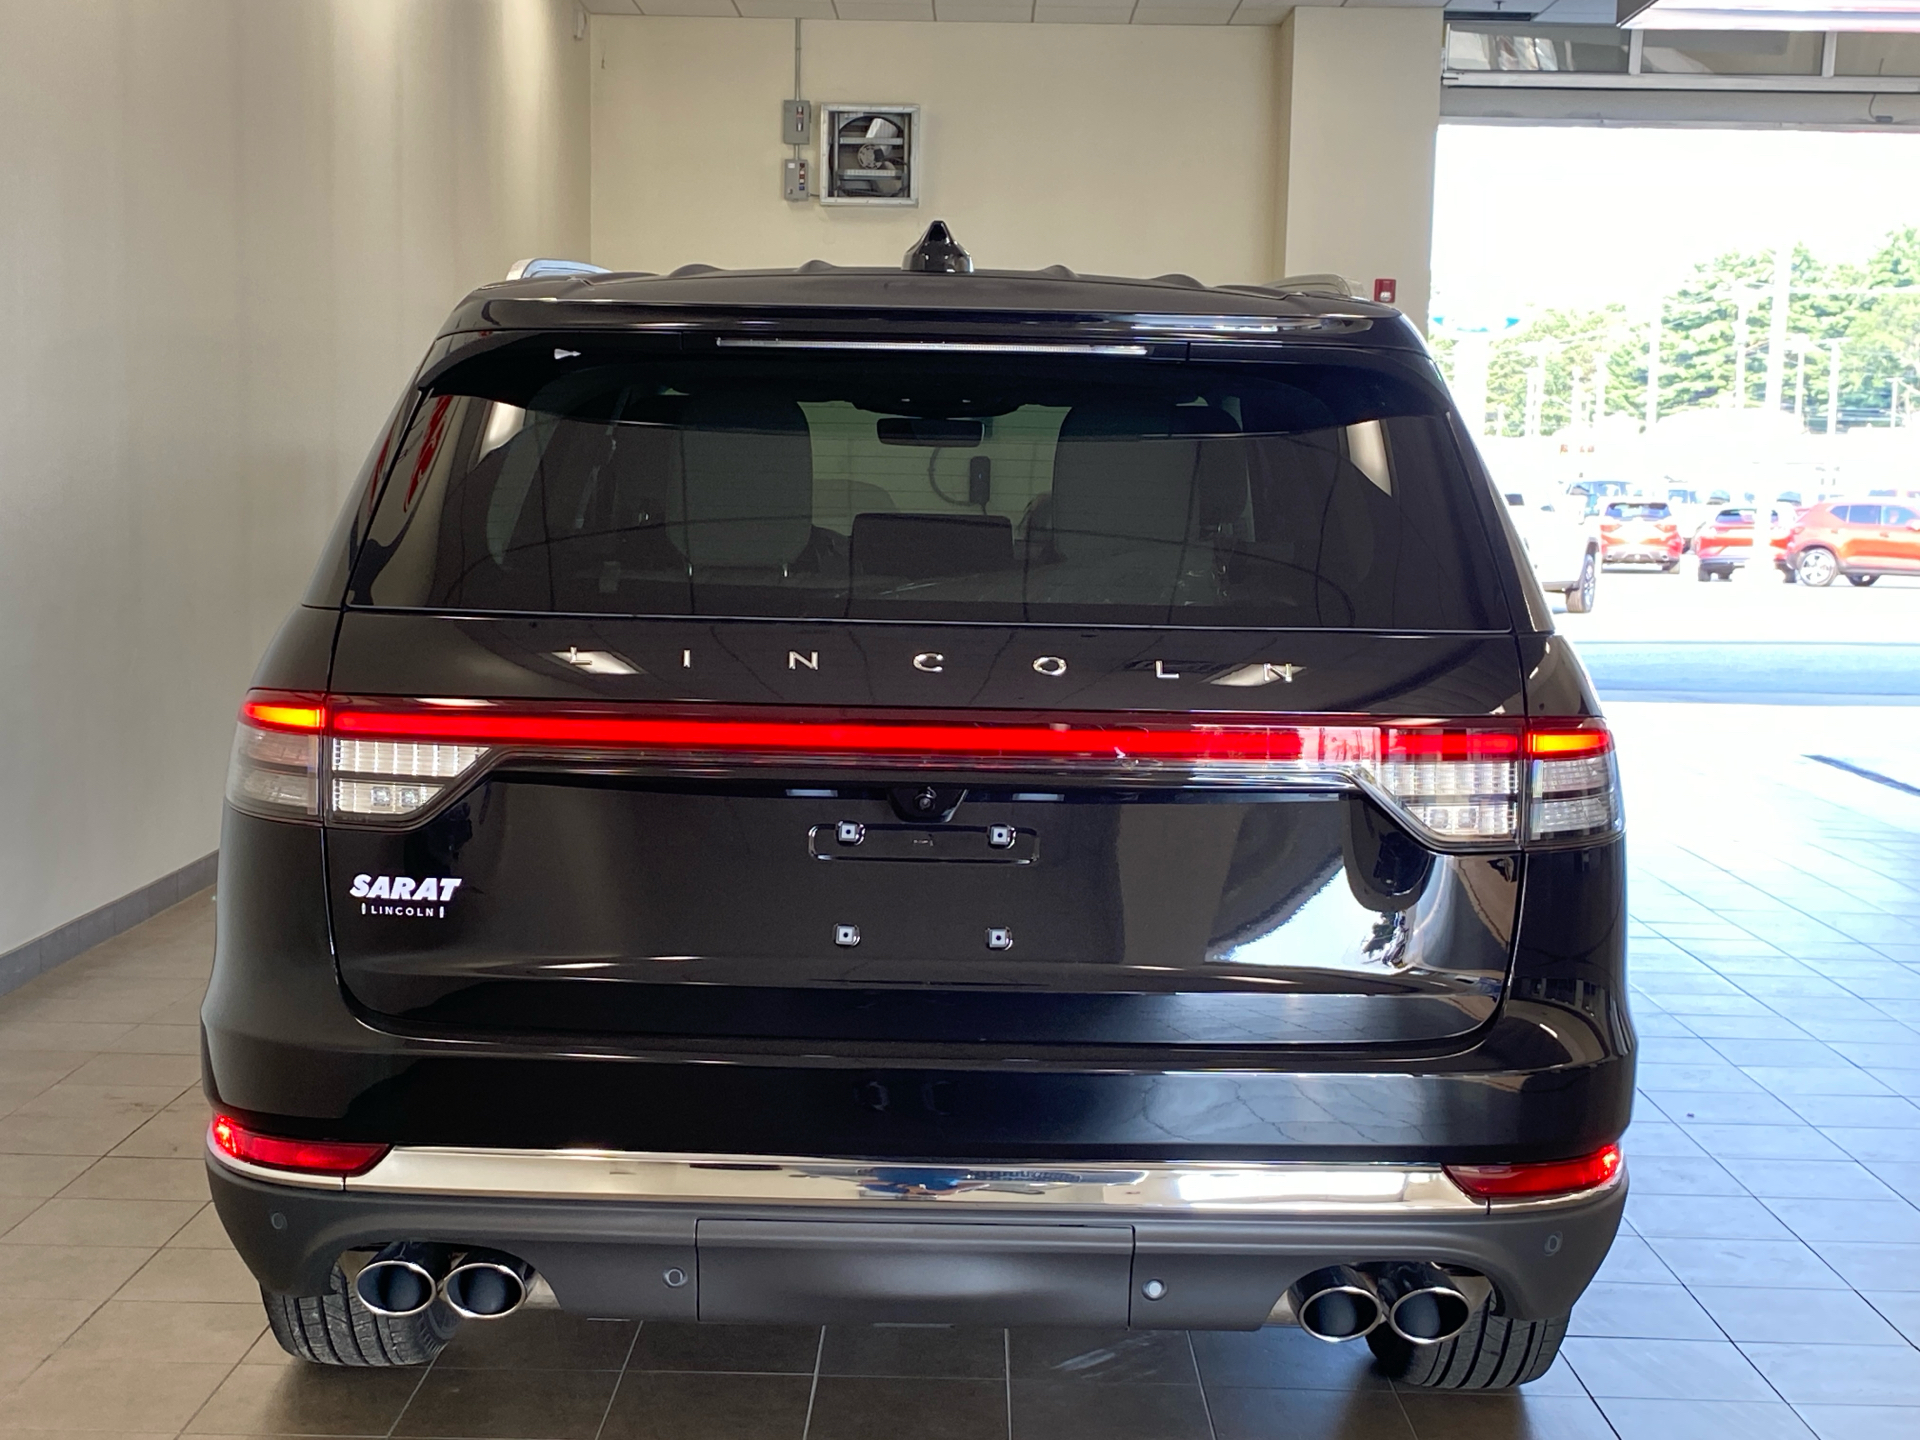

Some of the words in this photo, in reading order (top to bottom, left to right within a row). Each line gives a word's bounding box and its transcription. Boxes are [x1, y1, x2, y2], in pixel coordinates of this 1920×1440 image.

[570, 646, 1292, 682] LINCOLN
[349, 873, 463, 902] SARAT
[370, 904, 434, 917] LINCOLN
